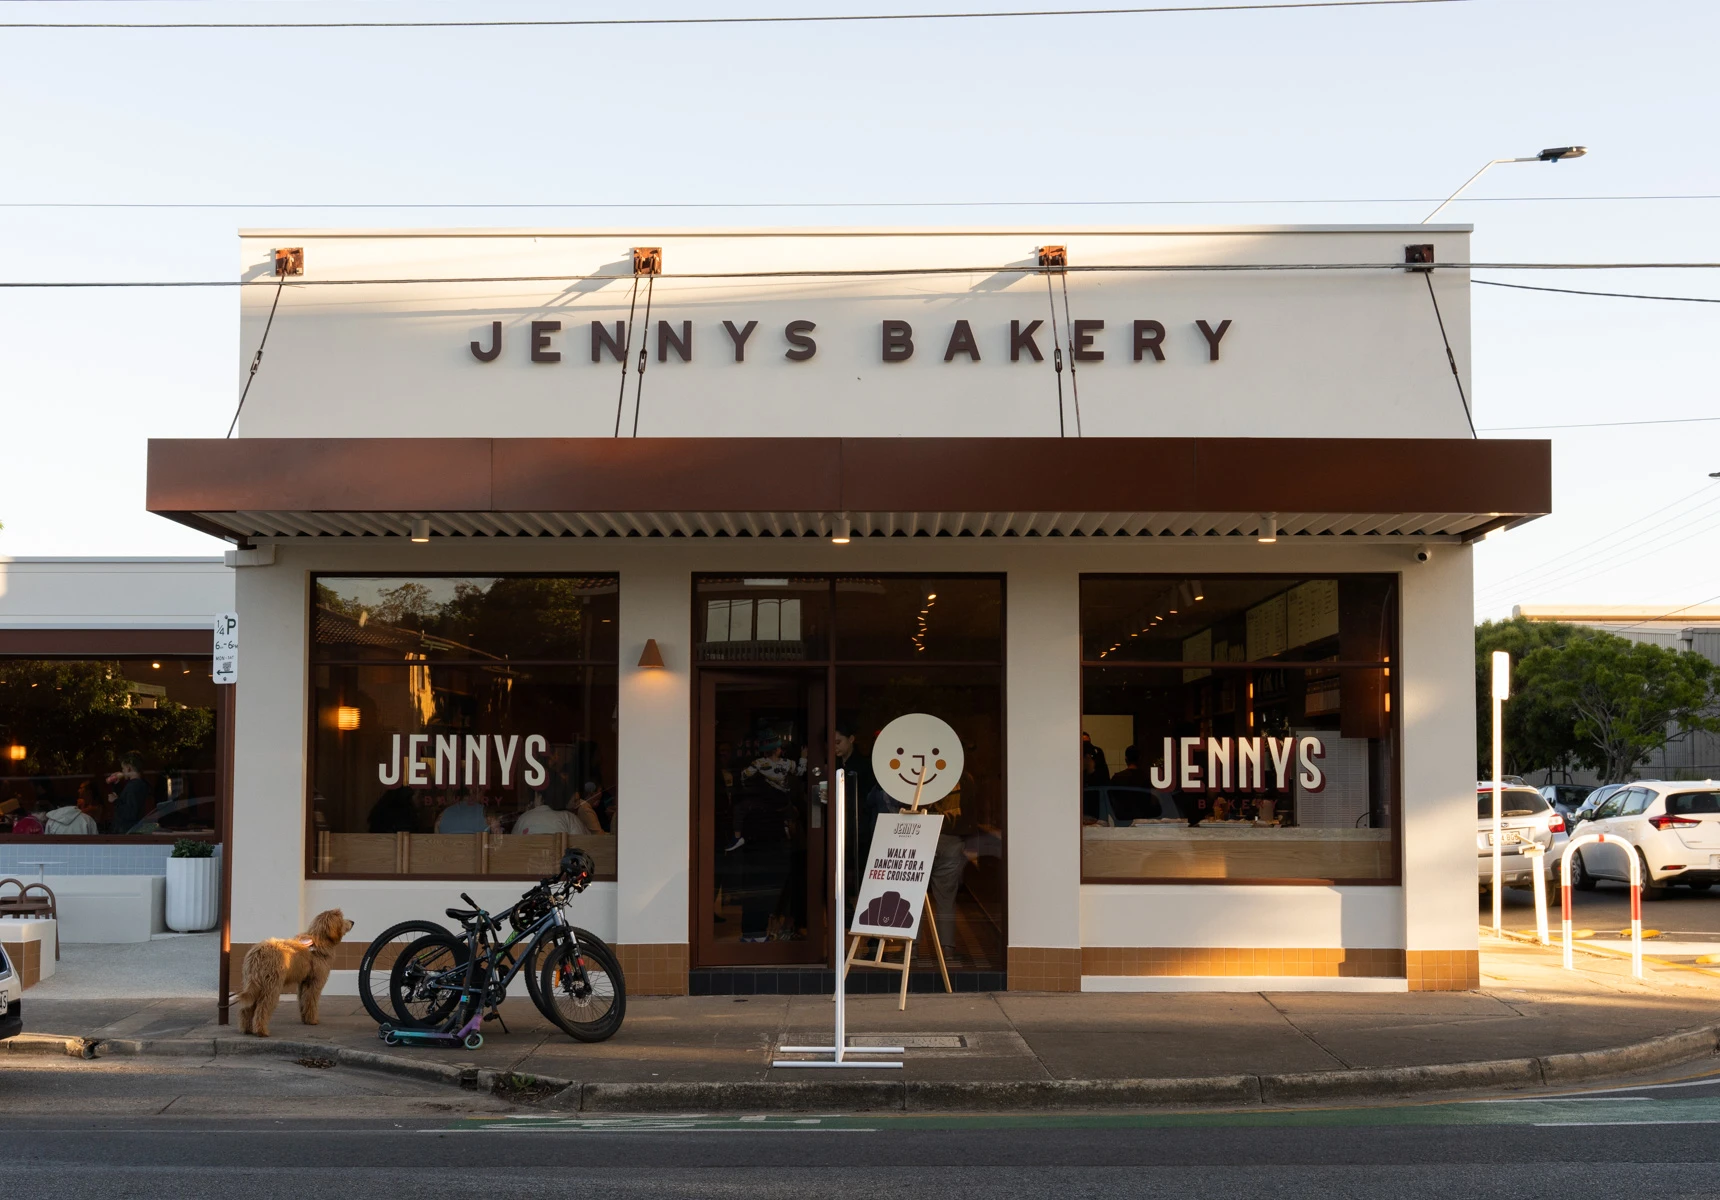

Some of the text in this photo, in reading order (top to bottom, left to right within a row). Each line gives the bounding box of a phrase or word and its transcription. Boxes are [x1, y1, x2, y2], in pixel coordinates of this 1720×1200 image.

[470, 319, 1233, 362] JENNYS BAKERY
[378, 734, 548, 789] JENNYS
[1150, 736, 1326, 792] JENNYS
[894, 823, 921, 835] JENNYS
[887, 848, 916, 859] WALK IN
[874, 859, 924, 871] DANCING FOR A
[869, 870, 924, 881] FREE CROISSANT
